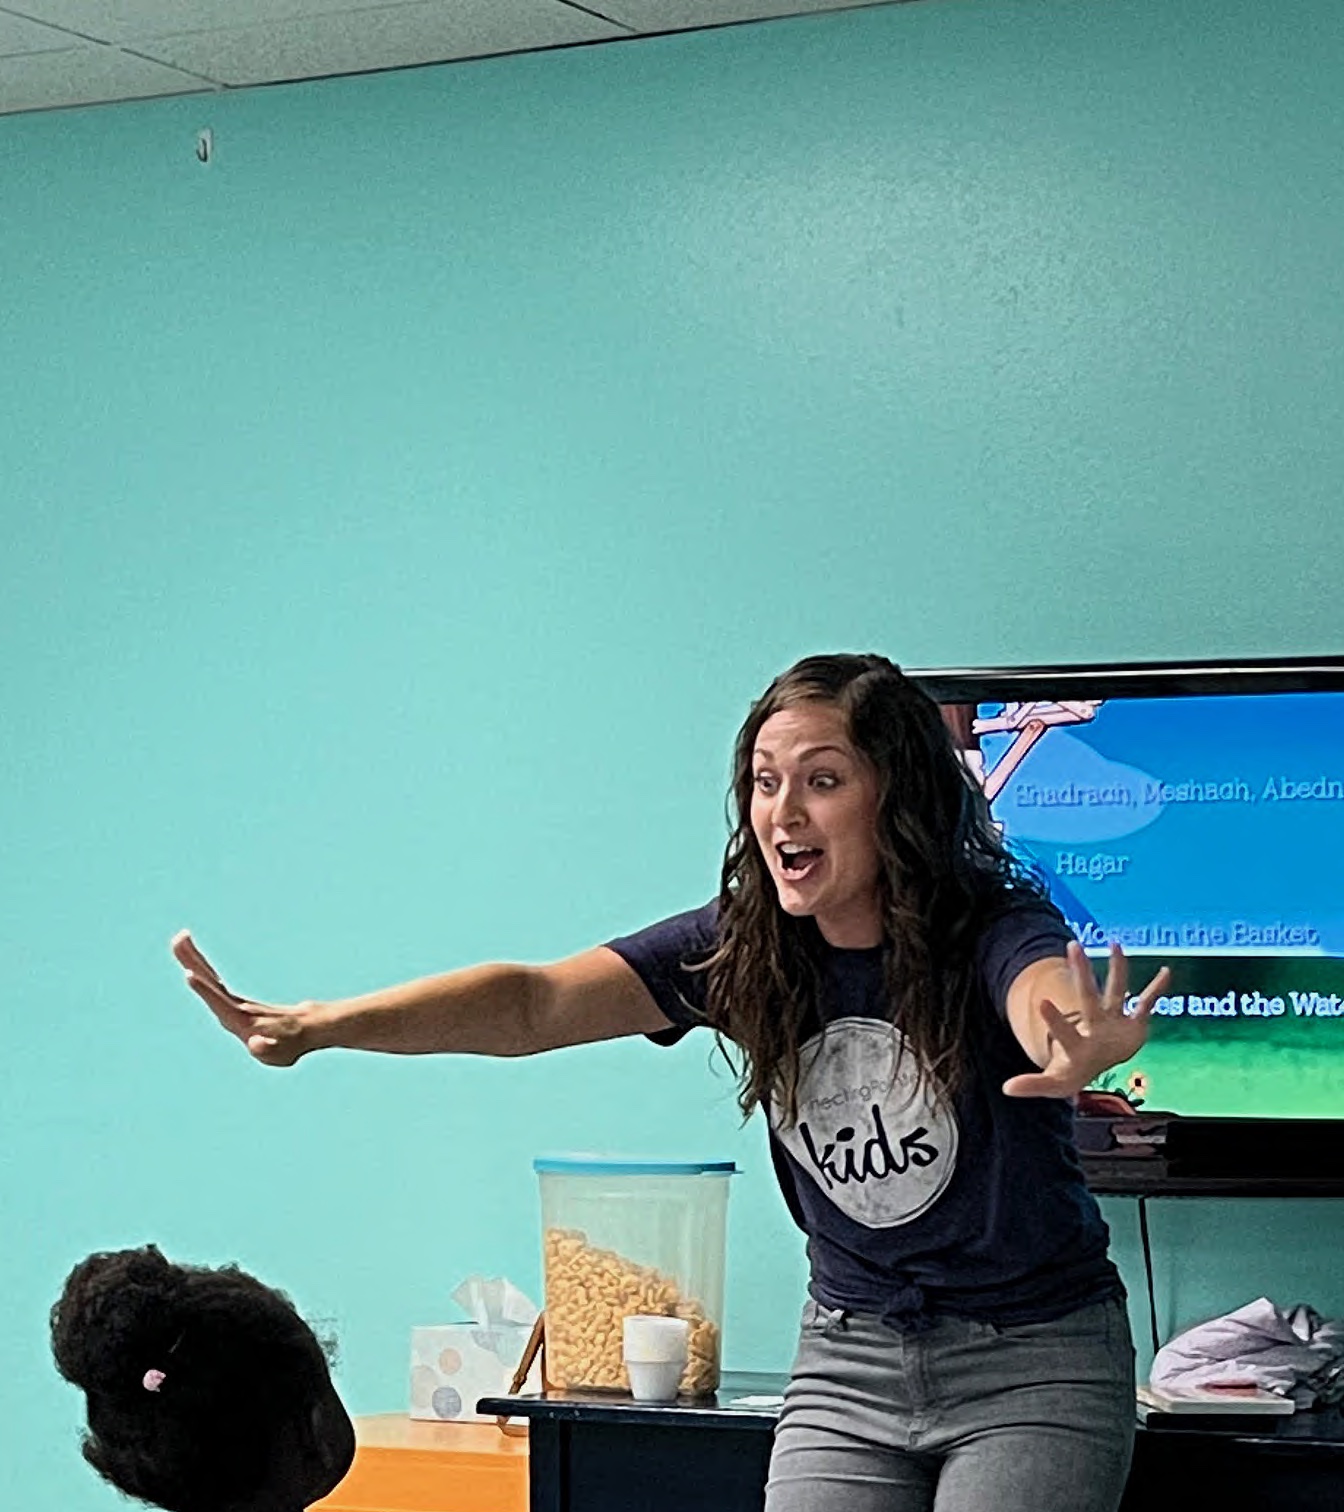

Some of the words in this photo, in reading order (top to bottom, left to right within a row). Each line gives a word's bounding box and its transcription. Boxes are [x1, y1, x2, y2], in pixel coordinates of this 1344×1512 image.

[1144, 777, 1257, 806] Meshach,
[1055, 852, 1130, 880] Hagar
[1152, 923, 1176, 945] in
[1182, 922, 1225, 945] the
[1230, 919, 1321, 945] Basket
[1187, 991, 1237, 1017] and
[1240, 991, 1286, 1017] the
[798, 1103, 939, 1190] kids
